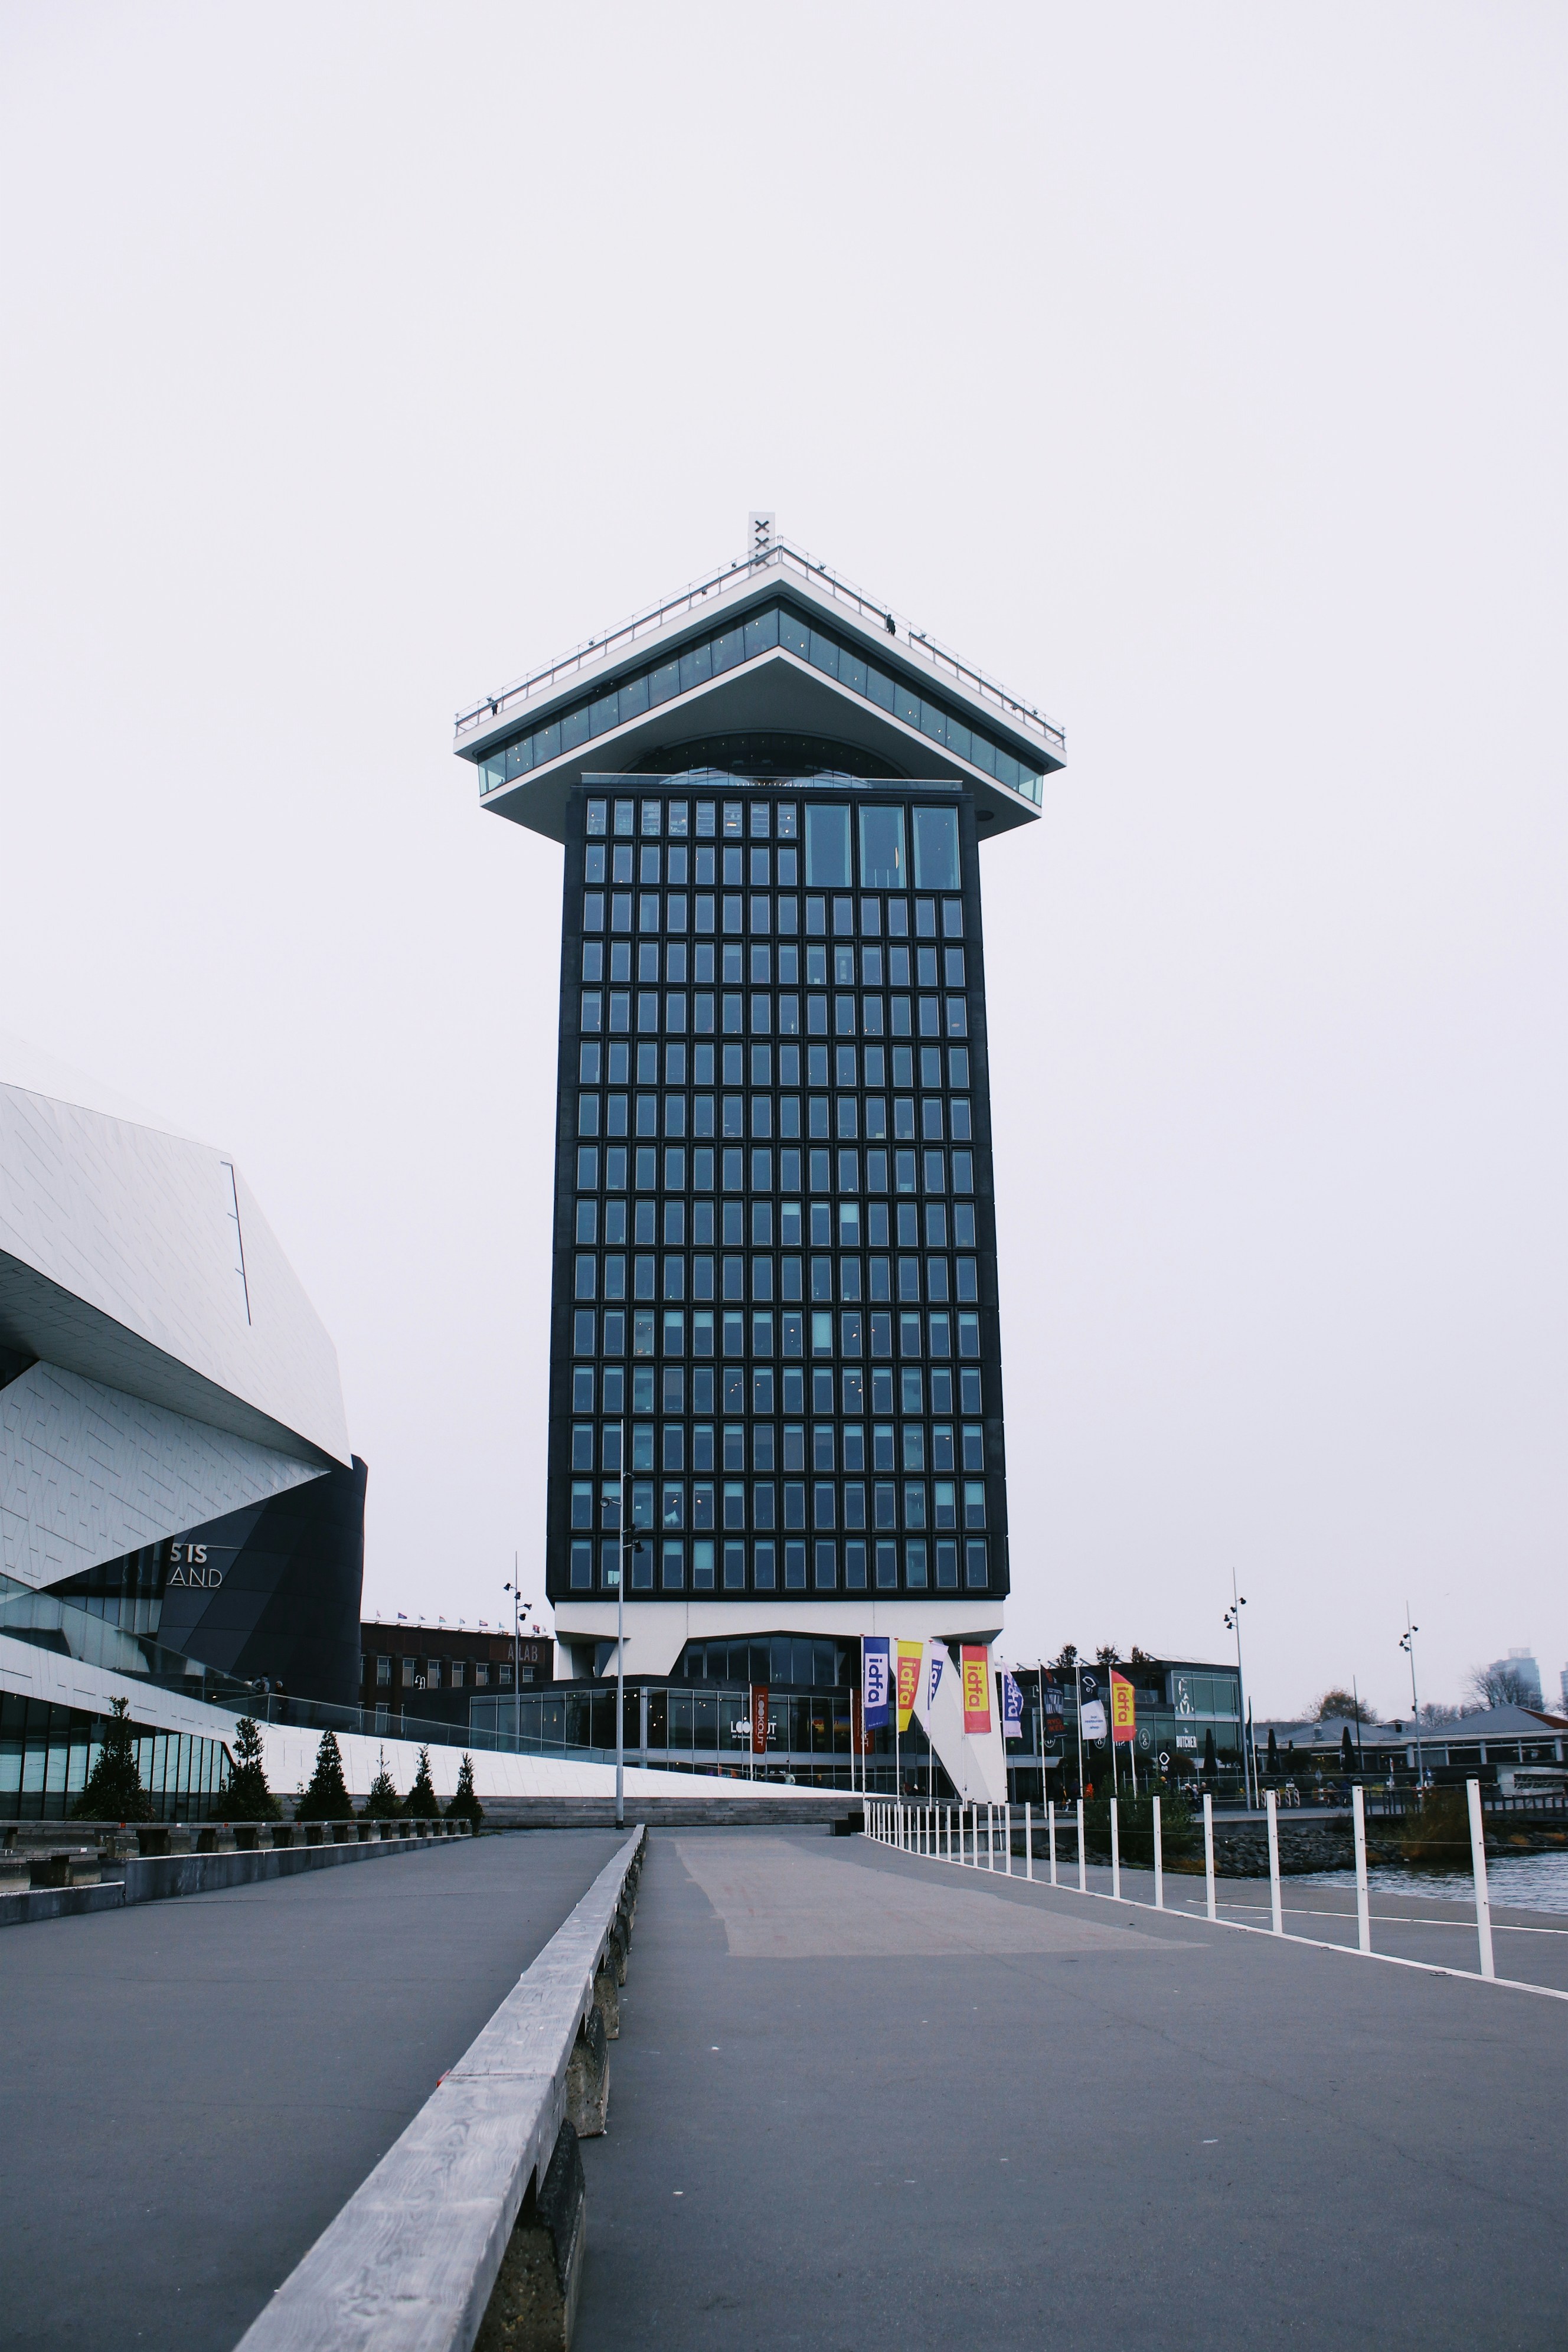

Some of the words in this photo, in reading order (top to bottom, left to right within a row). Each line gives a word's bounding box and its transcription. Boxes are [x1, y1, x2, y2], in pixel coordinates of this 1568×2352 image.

[170, 1566, 223, 1587] AND
[868, 1658, 883, 1703] idfa
[899, 1662, 916, 1705] idfa
[967, 1666, 983, 1707] idfa
[1116, 1687, 1130, 1722] idfa
[1175, 1735, 1197, 1748] BUTCHER
